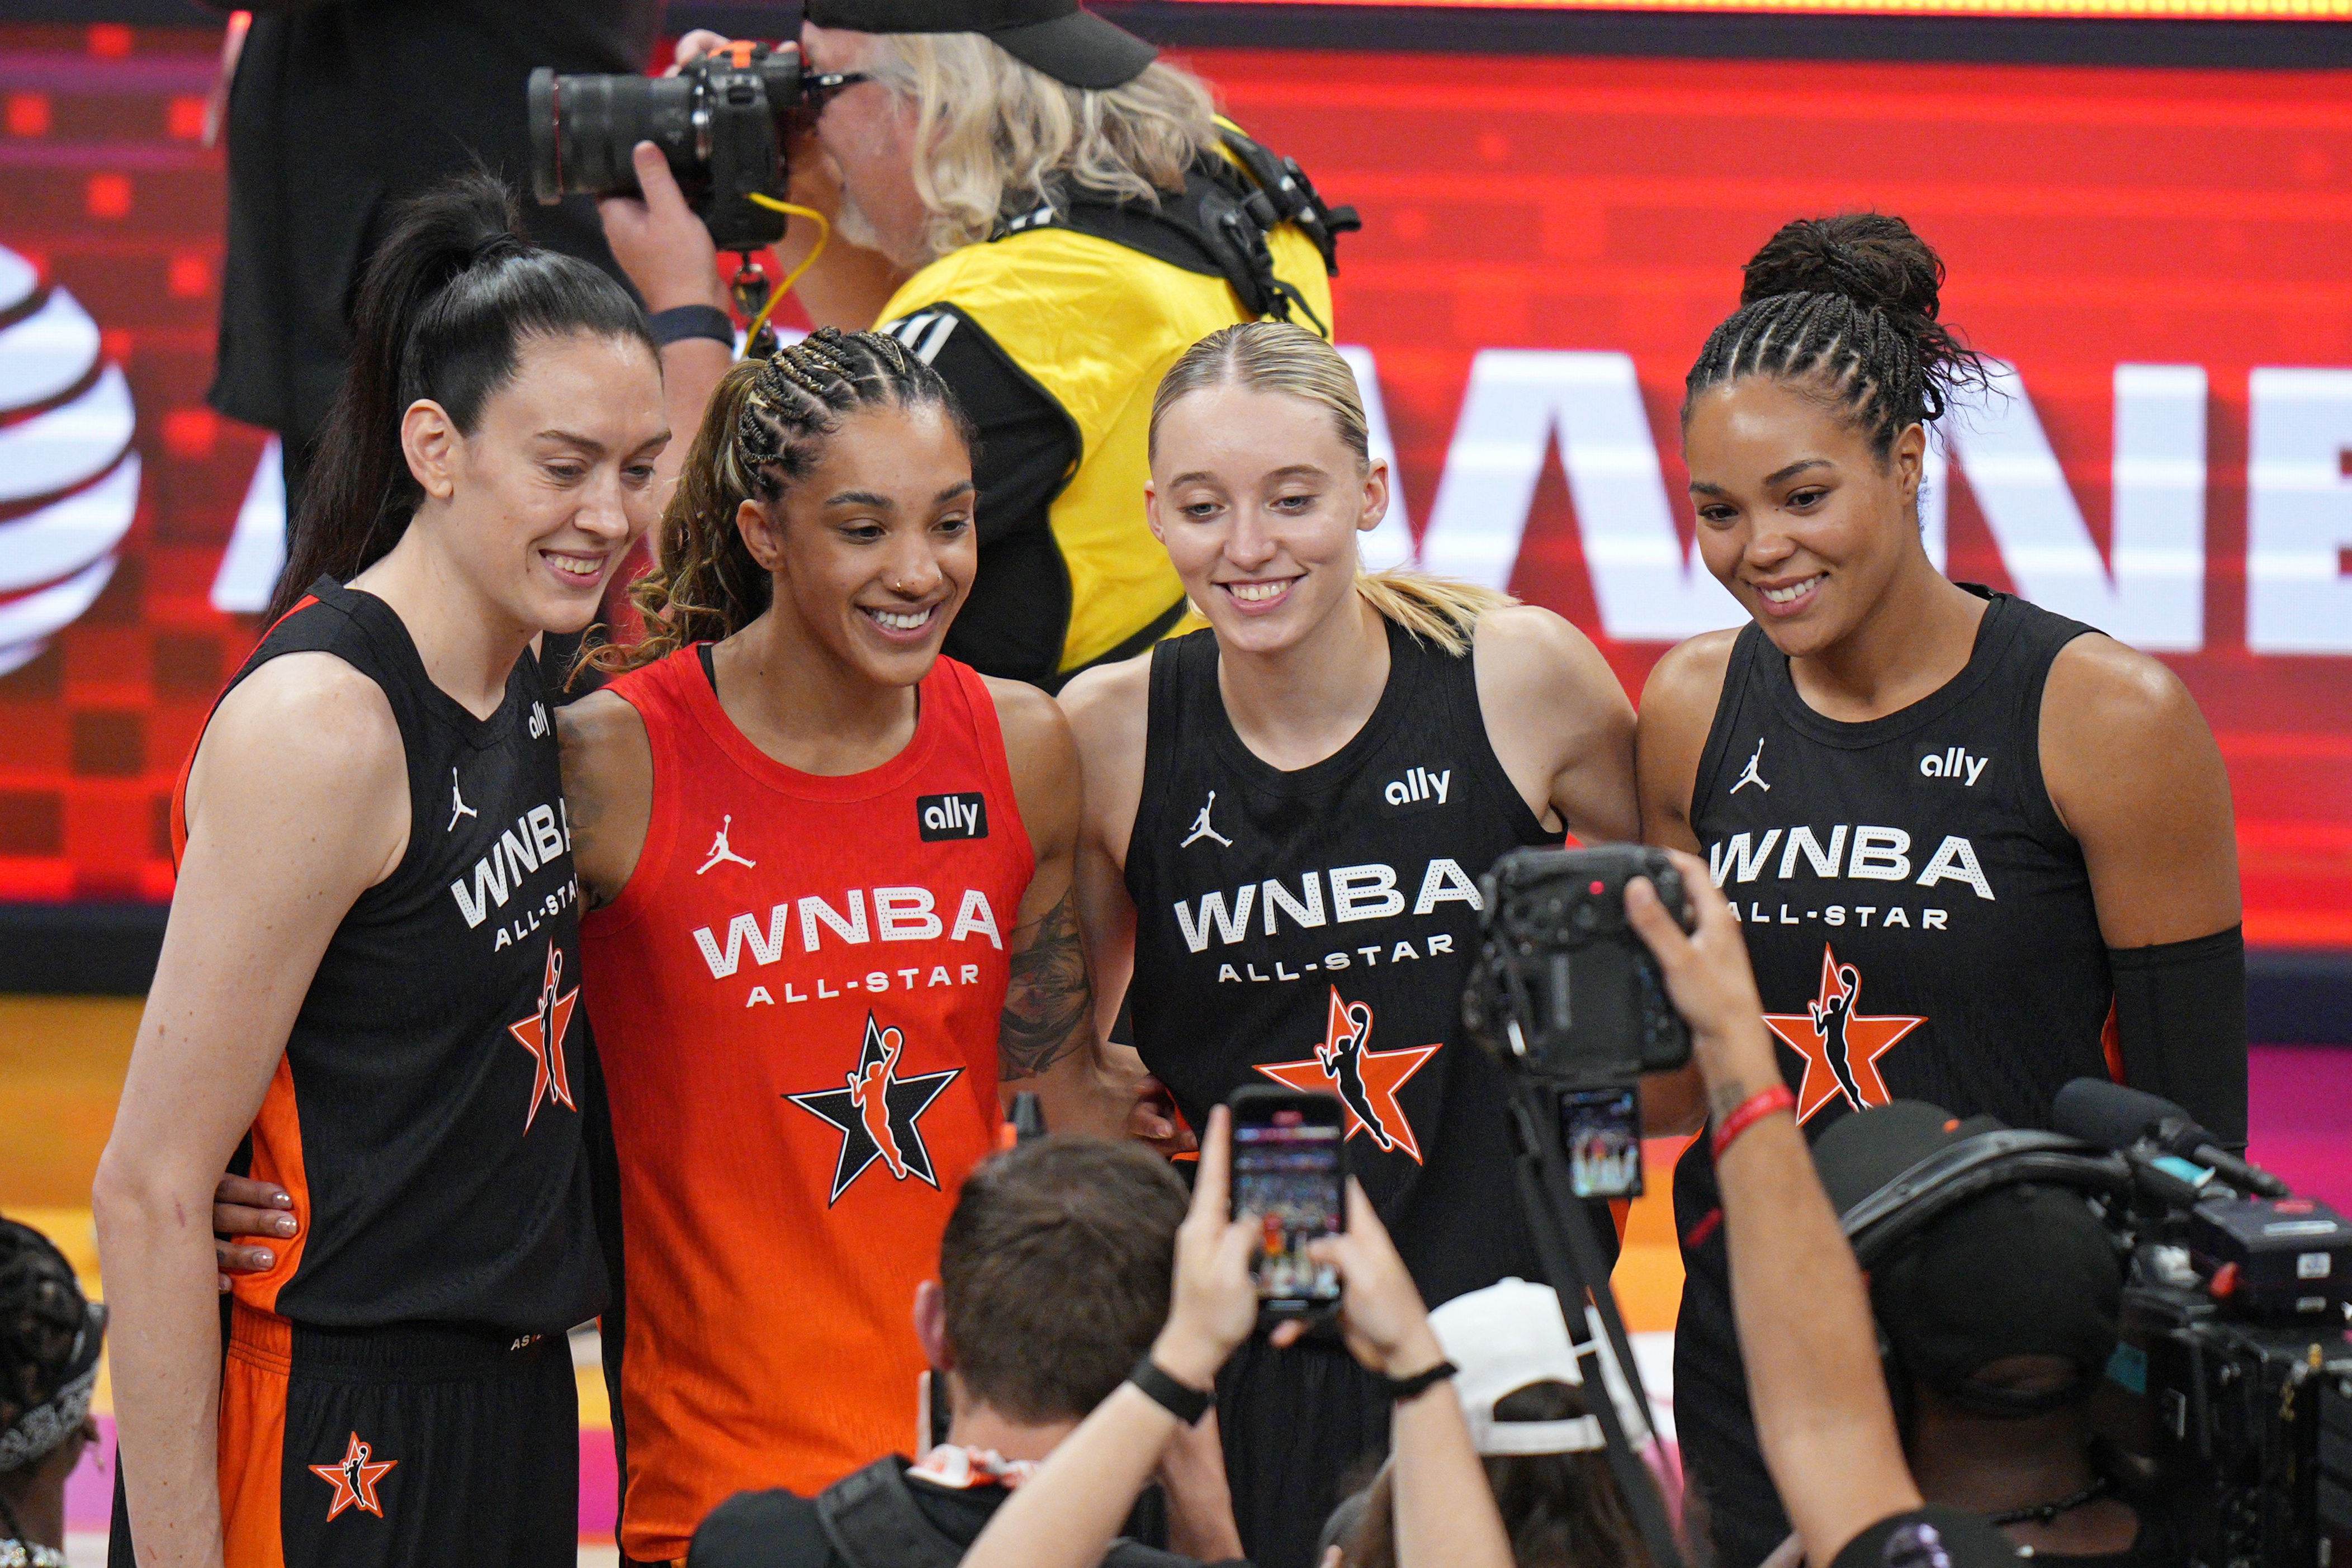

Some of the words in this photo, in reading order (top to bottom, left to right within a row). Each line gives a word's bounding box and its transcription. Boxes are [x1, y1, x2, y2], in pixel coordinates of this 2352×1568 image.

[529, 700, 550, 739] ally
[1385, 766, 1451, 806] ally
[1921, 747, 1989, 787] ally
[924, 795, 978, 835] ally
[1710, 825, 1995, 901] WNBA
[495, 872, 579, 953] ALL-STA
[1174, 859, 1484, 953] WNBA
[693, 887, 1004, 979] WNBA
[1218, 934, 1455, 982] ALL-STAR
[746, 964, 978, 1007] ALL-STAR
